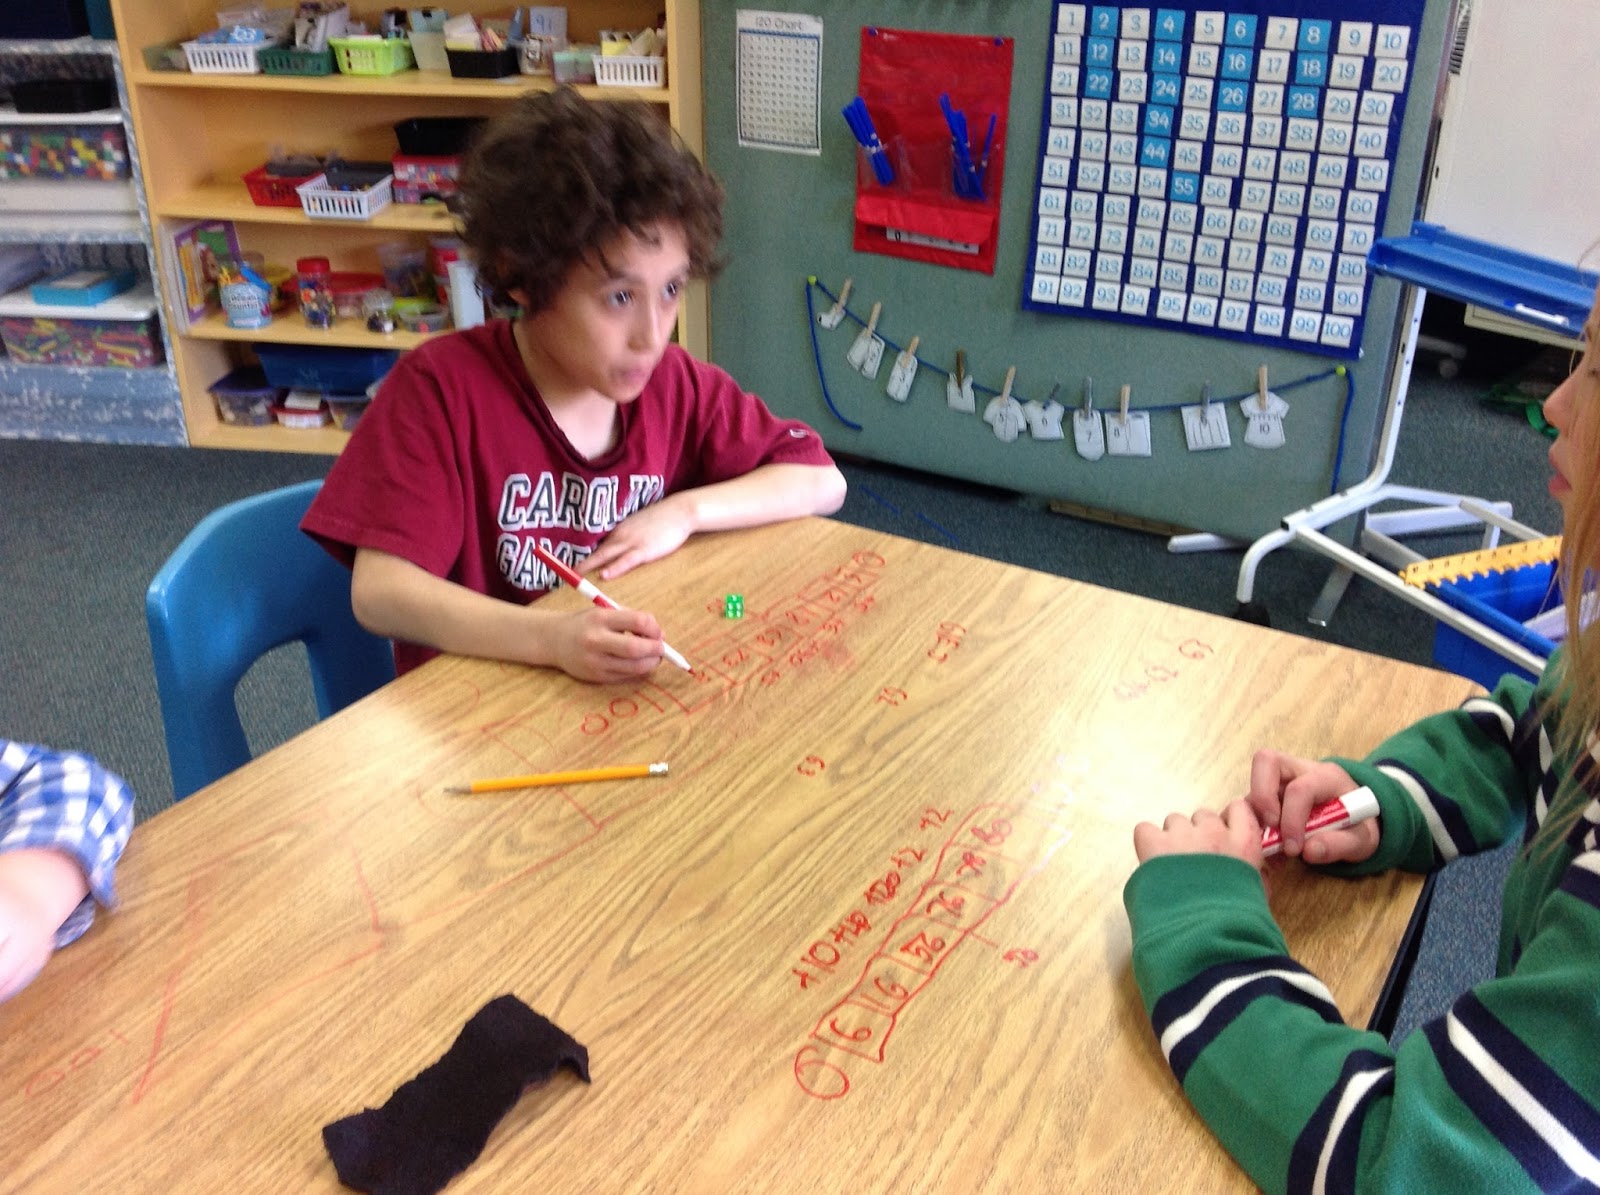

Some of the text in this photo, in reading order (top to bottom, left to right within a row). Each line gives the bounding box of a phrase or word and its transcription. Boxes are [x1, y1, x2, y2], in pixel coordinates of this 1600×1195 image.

[1067, 11, 1403, 48] 1 2 3 4 5 6 7 8 9 10
[1061, 41, 1401, 81] 11 12 13 14 15 16 17 18 19 20
[1057, 71, 1387, 115] 21 22 23 24 25 26 27 28 29 30
[1056, 103, 1382, 148] 31 32 33 34 35 36 37 38 39 40
[1052, 134, 1384, 180] 41 42 43 44 45 46 47 48 49 50
[1048, 161, 1373, 214] 51 52 53 54 55 56 57 58 59 60
[1043, 194, 1369, 245] 61 62 63 64 65 66 67 68 69 70
[1043, 223, 1364, 276] 71 72 73 74 75 76 77 78 79 80
[1040, 251, 1358, 305] 81 82 83 84 85 86 87 88 89 90
[1038, 281, 1351, 338] 91 92 93 94 95 96 97 98 99 100
[1259, 422, 1271, 435] 10
[829, 1017, 873, 1043] 6
